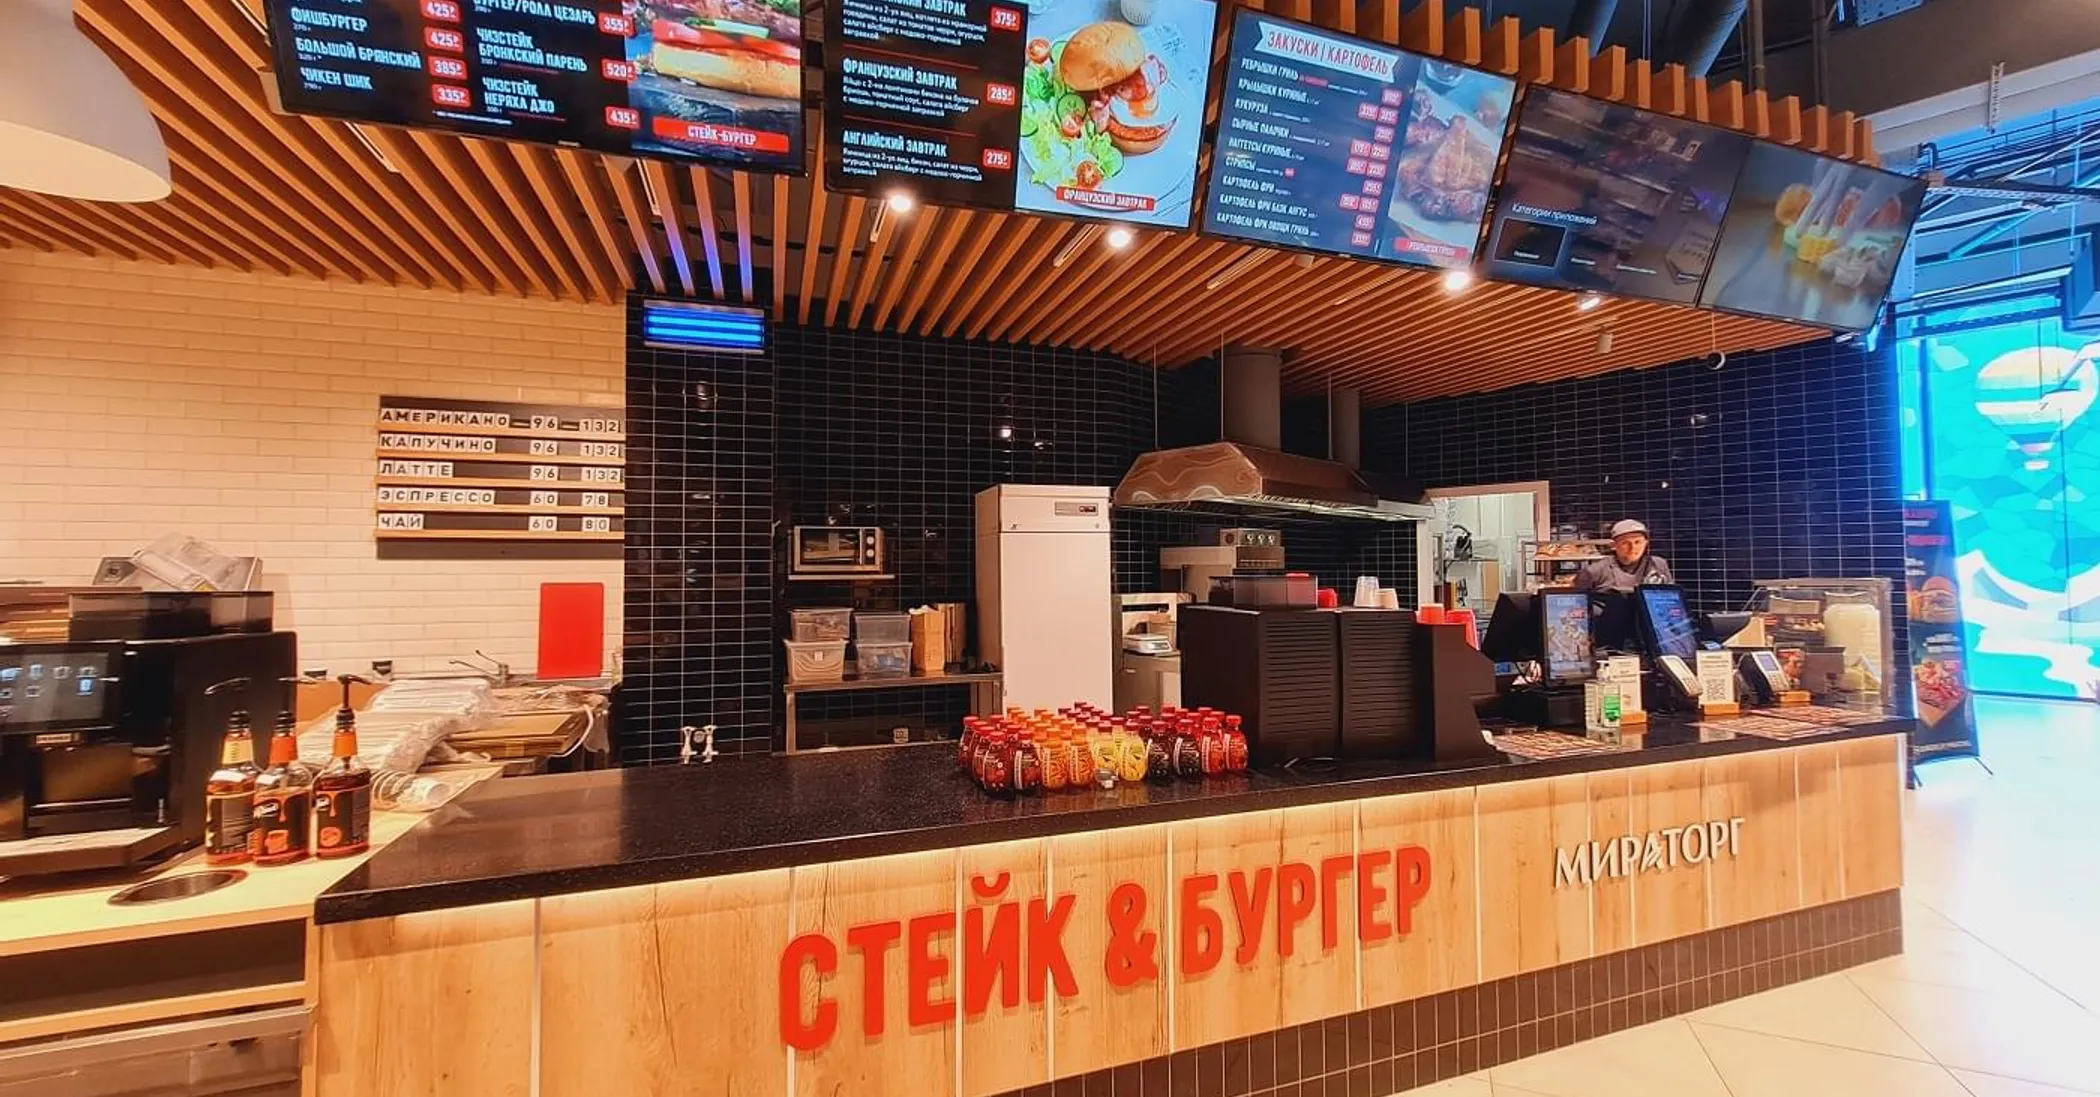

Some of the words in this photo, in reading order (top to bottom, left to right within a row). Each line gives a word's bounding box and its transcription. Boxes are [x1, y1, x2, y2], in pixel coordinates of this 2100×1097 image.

[554, 5, 596, 25] ЦЕЗАРЬ
[924, 0, 966, 17] ЗАВТРАК
[291, 7, 367, 32] ФИШБУРГЕР
[476, 27, 534, 49] ЧИЗСТЕЙК
[295, 37, 356, 60] БОЛЬШОЙ
[358, 47, 421, 69] БРЯНСКИЙ
[479, 43, 544, 66] БРОНКСКИЙ
[546, 54, 588, 72] ПАРЕНЬ
[1267, 31, 1319, 57] ЗАКУСКИ
[1327, 46, 1389, 75] КАРТОФЕЛЬ
[301, 67, 341, 84] ЧИКЕН
[344, 74, 373, 90] ШИК
[843, 58, 914, 83] ФРАНЦУЗСКИЙ
[916, 73, 957, 90] ЗАВТРАК
[482, 77, 539, 97] ЧИЗСТЕЙК
[484, 92, 528, 111] НЕРЯХА
[530, 99, 555, 114] ДЖО
[688, 124, 757, 145] СТЕЙК-БУРГЕР
[843, 130, 905, 151] АНГЛИЙСКИЙ
[906, 140, 947, 157] ЗАВТРАК
[1222, 175, 1257, 192] КАРТОФЕЛЬ
[1063, 189, 1115, 205] ФРАНЦУЗСКИЙ
[1116, 195, 1148, 209] ЗАВТРАК
[1219, 194, 1255, 210] КАРТОФЕЛЬ
[1512, 202, 1551, 217] Категории
[1216, 212, 1253, 229] КАРТОФЕЛЬ
[381, 409, 509, 427] АМЕРИКАНО
[533, 418, 557, 430] 96
[583, 420, 618, 432] 132
[381, 436, 494, 451] КАПУЧИНО
[533, 442, 556, 454] 96
[584, 445, 618, 457] 132
[381, 462, 451, 476] ЛАТТЕ
[533, 467, 556, 479] 96
[585, 469, 618, 481] 132
[381, 490, 493, 503] ЭСПРЕССО
[533, 493, 555, 504] 60
[585, 494, 606, 506] 78
[381, 514, 422, 528] ЧАЙ
[532, 518, 554, 530] 60
[585, 518, 607, 530] 80
[1555, 817, 1746, 889] МИРАТОРГ
[778, 872, 1080, 1052] СТЕЙК
[1105, 882, 1159, 988] &
[1181, 844, 1432, 981] БУРГЕР
